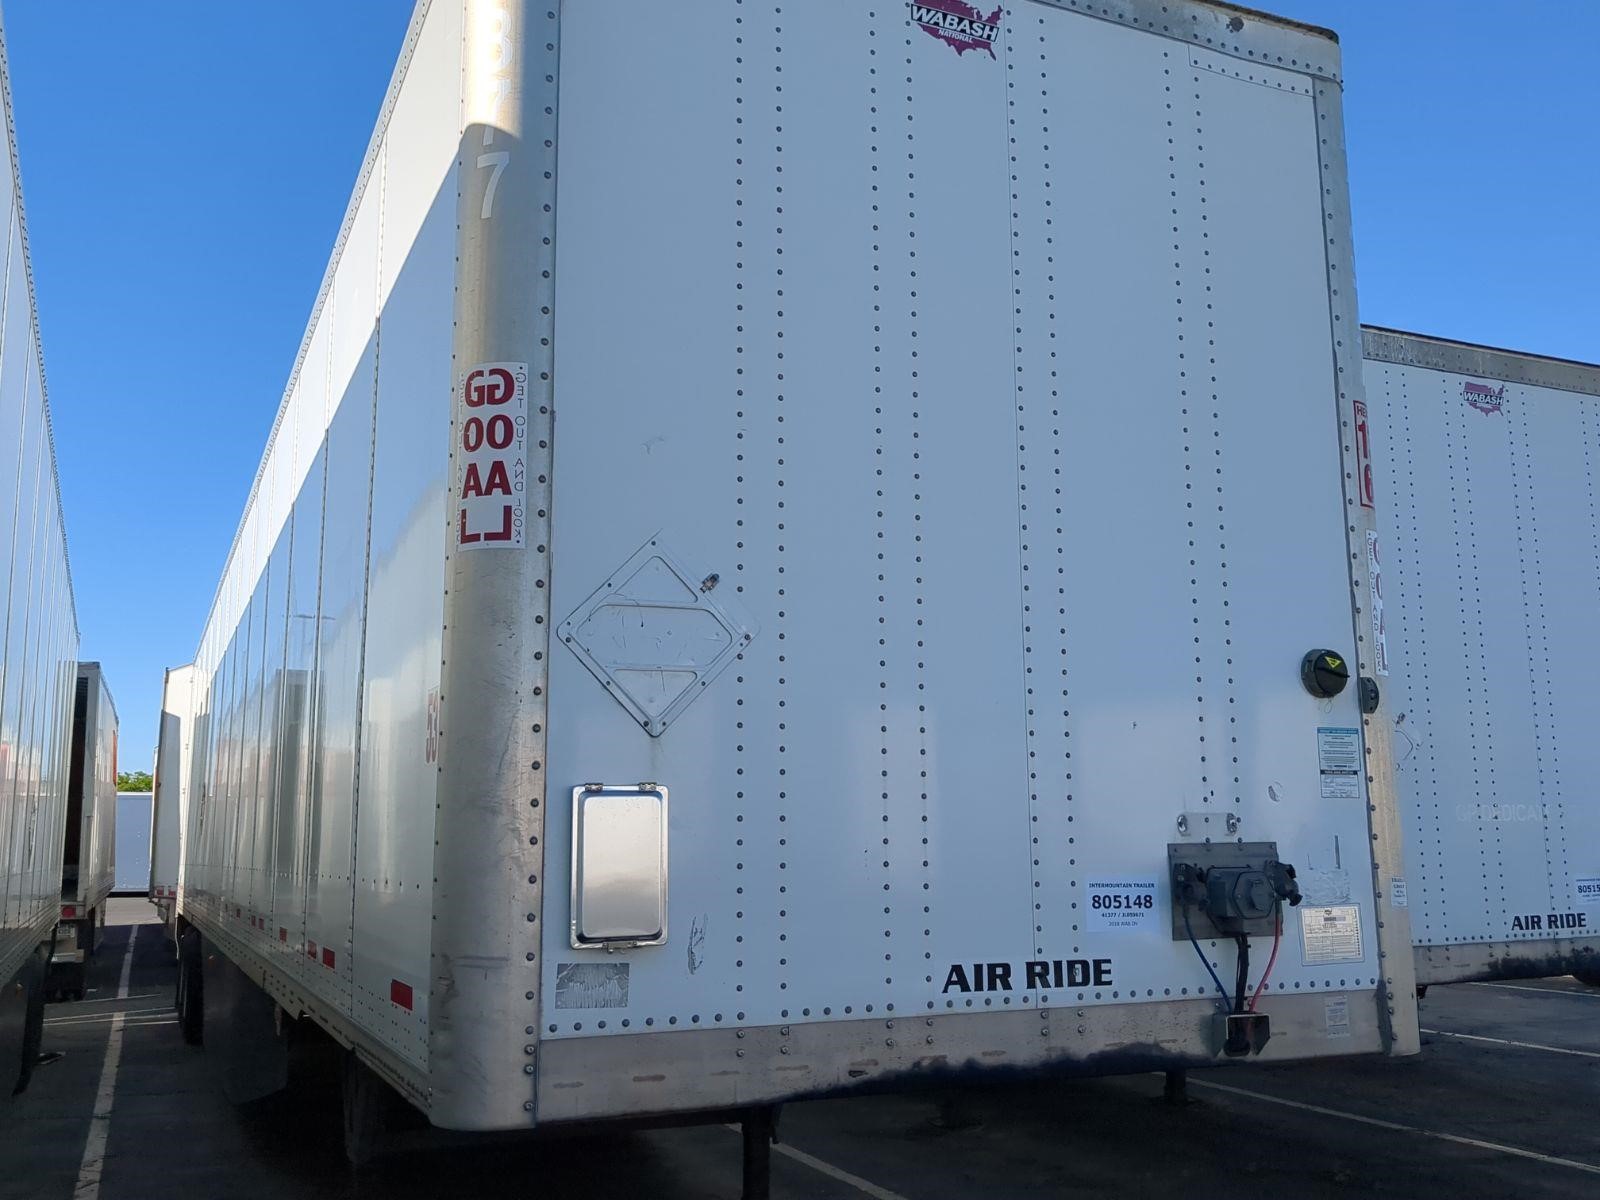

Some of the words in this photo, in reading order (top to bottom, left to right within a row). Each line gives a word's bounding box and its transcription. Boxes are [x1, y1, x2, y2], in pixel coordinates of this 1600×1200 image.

[911, 5, 999, 42] WABASH
[938, 28, 974, 43] NATIONAL
[1463, 391, 1503, 406] WABASH
[1091, 894, 1153, 909] 805148
[1511, 915, 1543, 931] AIR
[1547, 913, 1587, 929] RIDE
[942, 963, 1013, 994] AIR
[1025, 958, 1113, 990] RIDE
